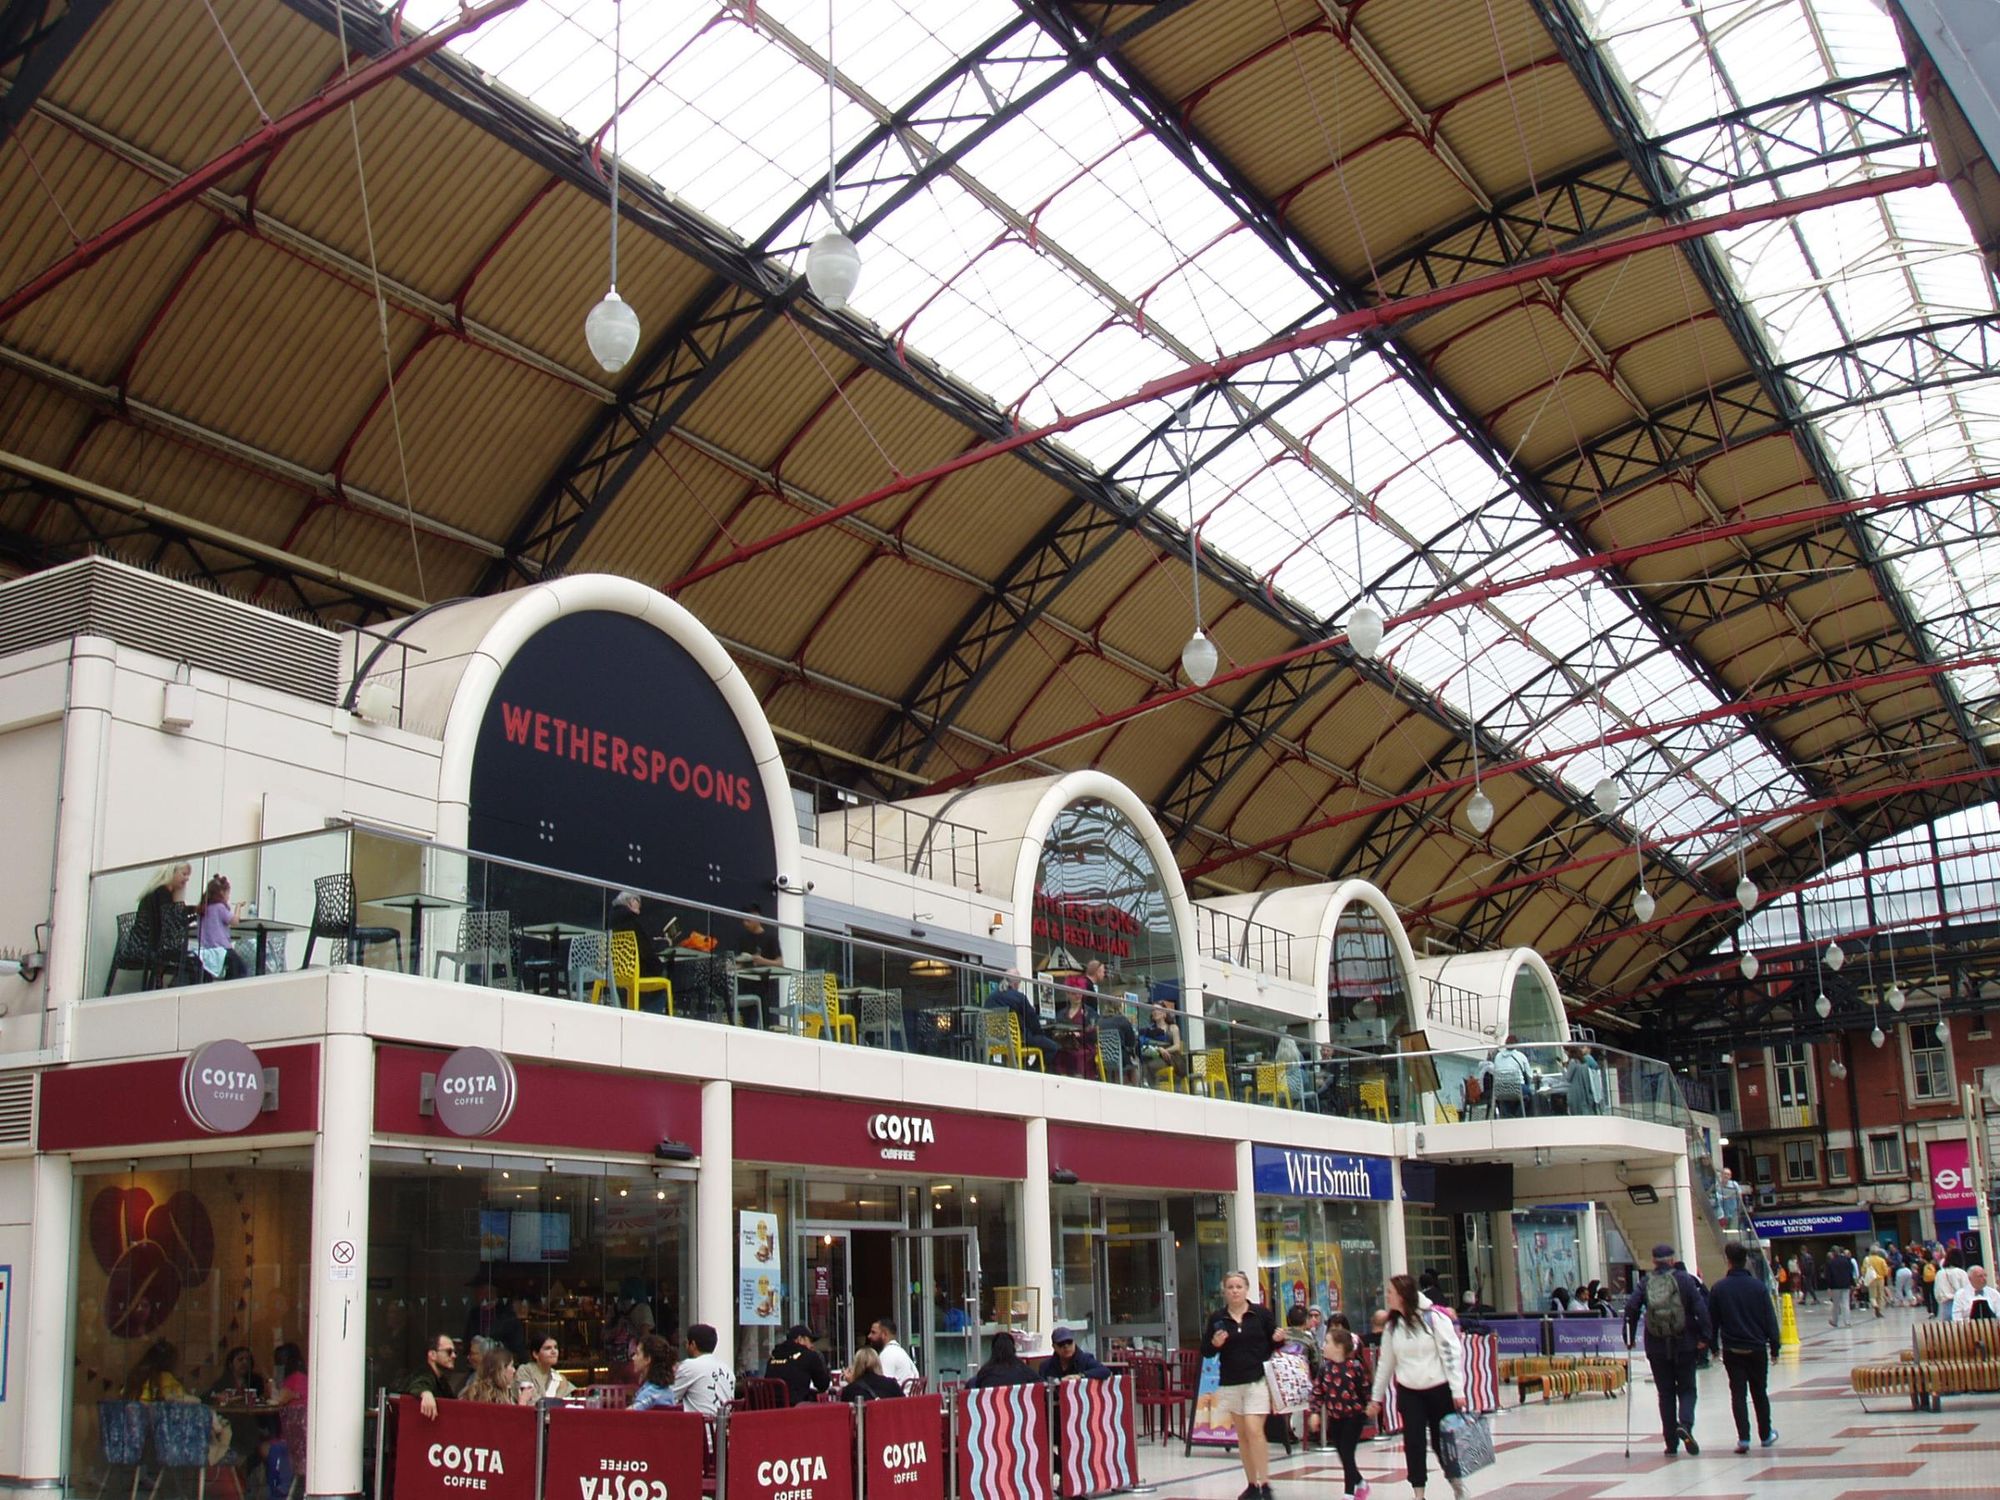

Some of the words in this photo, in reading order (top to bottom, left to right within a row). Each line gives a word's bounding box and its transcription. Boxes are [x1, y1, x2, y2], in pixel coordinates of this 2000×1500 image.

[502, 702, 752, 811] WETHERSPOONS
[202, 1068, 258, 1090] COSTA
[443, 1075, 497, 1095] COSTA
[213, 1090, 245, 1102] COFFEE
[454, 1096, 484, 1106] COFFEE
[868, 1113, 935, 1145] COSTA
[880, 1147, 916, 1161] COFFEE
[1284, 1151, 1371, 1197] WHSmith
[1937, 1191, 1960, 1200] visitor
[1754, 1220, 1787, 1228] VICTORIA
[1787, 1215, 1843, 1226] UNDERGROUND
[1783, 1225, 1813, 1233] STATION
[1498, 1335, 1537, 1344] Assistance
[1559, 1334, 1600, 1345] Passenger
[428, 1443, 504, 1474] COSTA
[883, 1441, 927, 1469] COSTA
[599, 1459, 648, 1472] COFFEE
[757, 1456, 828, 1487] COSTA
[443, 1475, 487, 1490] COFFEE
[894, 1471, 918, 1485] COFFEE
[579, 1475, 668, 1500] COSTA
[774, 1488, 813, 1500] COFFEE
